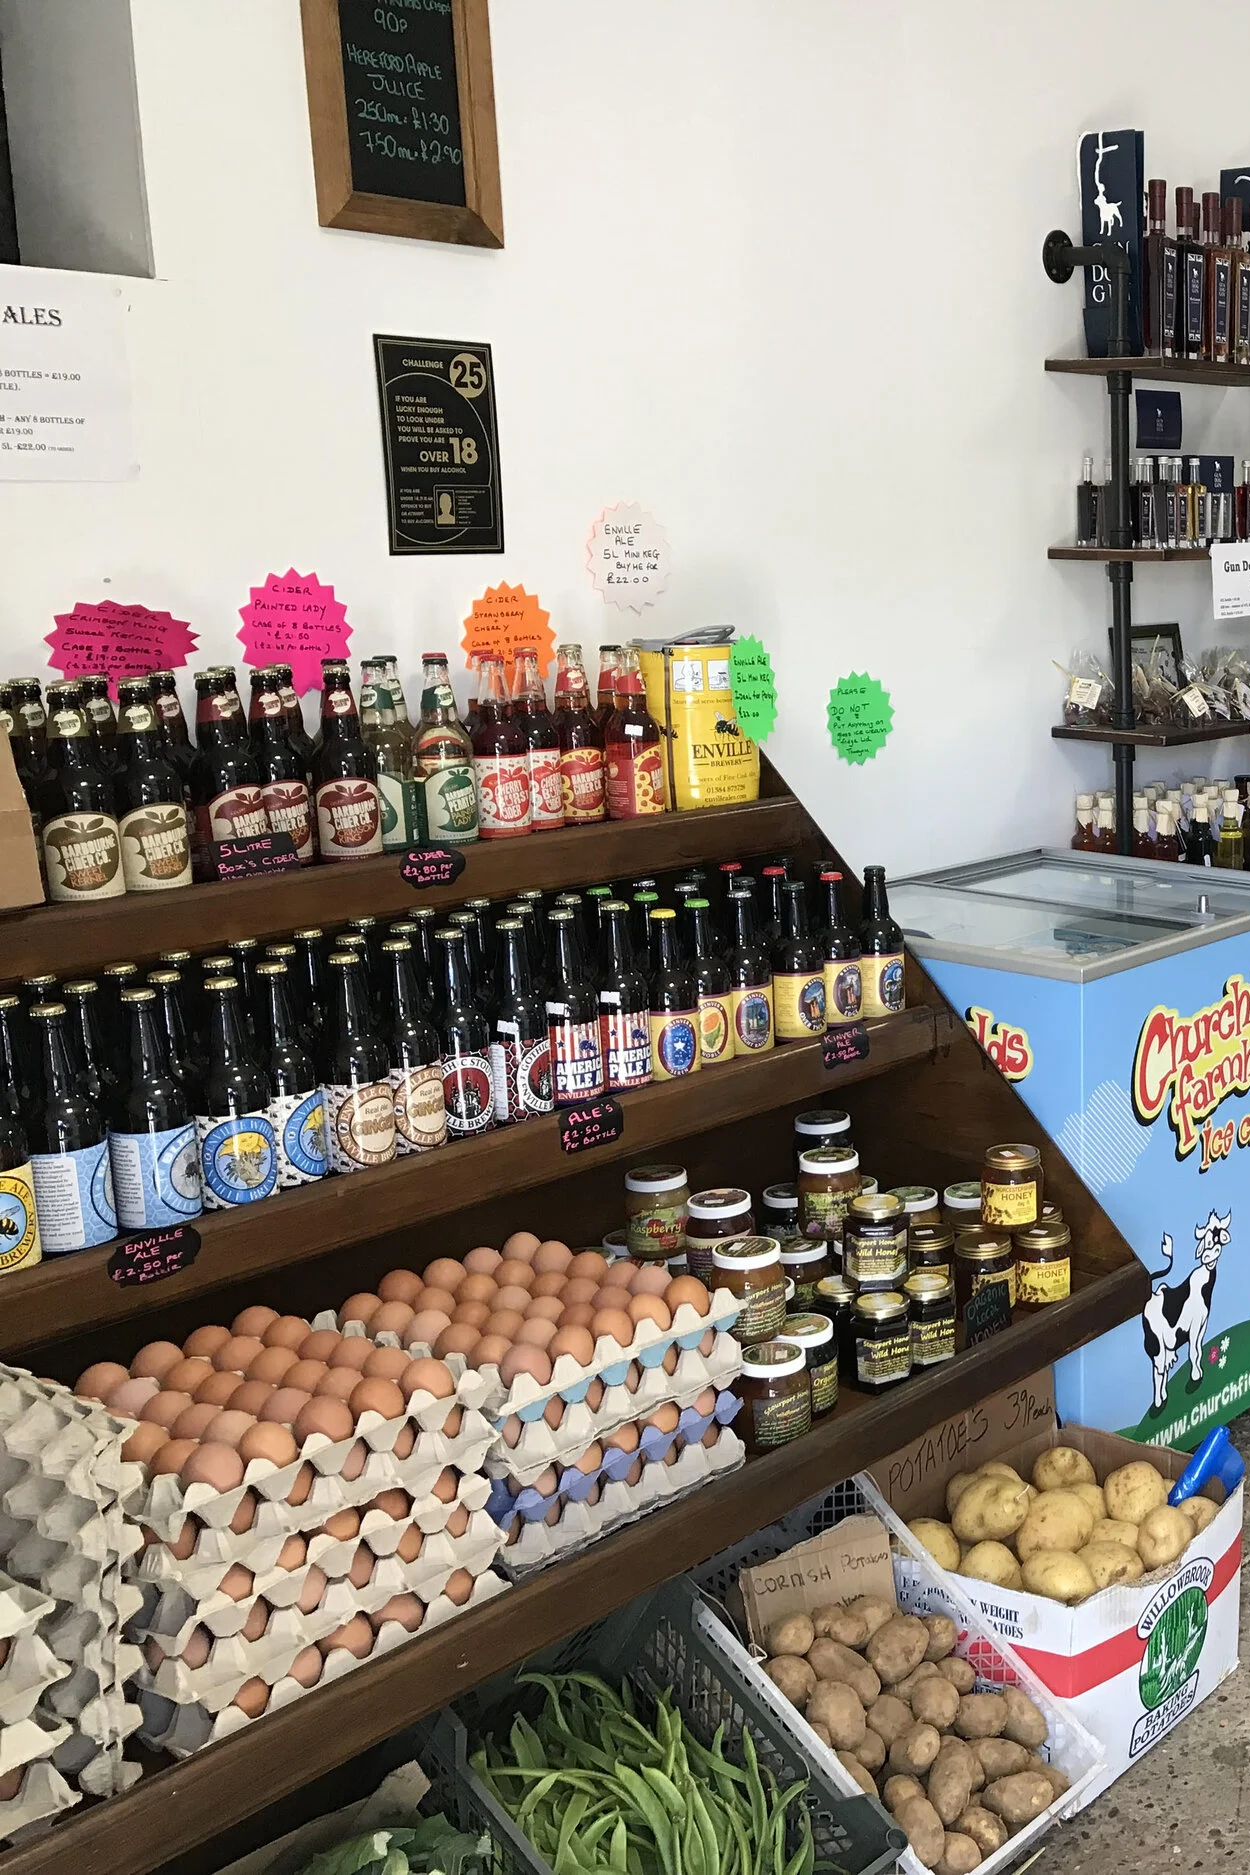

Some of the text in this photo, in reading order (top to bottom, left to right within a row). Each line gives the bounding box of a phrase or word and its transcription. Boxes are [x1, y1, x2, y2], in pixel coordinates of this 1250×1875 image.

[347, 43, 442, 80] HEREFORD APPLE
[367, 74, 425, 100] JUICE
[412, 107, 449, 134] £1.30
[421, 139, 462, 165] £2.90
[3, 306, 62, 327] ALES
[5, 370, 80, 381] BOTTLES £19.00
[402, 359, 483, 389] CHALLENGE 25
[417, 406, 443, 414] ENOUGH
[15, 415, 31, 423] ANY
[40, 416, 74, 424] BOTTLES
[425, 416, 445, 424] UNDER
[420, 437, 478, 464] OVER 18
[605, 524, 642, 534] ENVILLE
[615, 535, 634, 546] ALE
[603, 549, 660, 560] 5L MINI KEG
[616, 562, 631, 572] BUY
[1224, 561, 1240, 572] Gun
[607, 572, 649, 584] £22.00
[272, 585, 312, 595] CIDER
[97, 606, 159, 621] CIDER
[255, 599, 326, 620] PAINTED LADY
[475, 611, 524, 620] STRAWBERRY
[70, 614, 128, 625] CRIMSON
[252, 620, 272, 628] CASE
[475, 624, 509, 632] CHERRY
[838, 688, 866, 696] PLEASE
[831, 703, 870, 716] DO NOT
[692, 740, 752, 759] ENVILLE
[710, 759, 742, 767] BREWERY
[495, 779, 522, 797] CHERRY
[574, 782, 595, 795] CIDER
[497, 792, 529, 807] BURST
[331, 798, 376, 819] BARBOURNE
[499, 805, 522, 819] CIDER
[272, 816, 295, 833] CIDER
[334, 814, 373, 832] CIDER CO.
[453, 816, 471, 827] LADY
[337, 823, 375, 838] CRIMSON
[60, 833, 116, 859] BARBOURNE
[339, 833, 362, 844] KING
[145, 844, 171, 861] CIDER
[219, 838, 272, 858] 5 LITRE
[64, 851, 111, 872] CIDER CO.
[150, 858, 180, 870] SWEET
[262, 853, 298, 866] CIDER
[408, 851, 451, 862] CIDER
[69, 865, 103, 880] SWEET
[403, 864, 437, 876] £2.80
[71, 872, 109, 888] KERNEL
[800, 1012, 813, 1029] OVER
[823, 1027, 862, 1044] KINVER
[836, 1040, 851, 1048] ALE
[522, 1042, 550, 1072] GOTHIC
[609, 1062, 643, 1078] PALE
[557, 1072, 593, 1091] PALE
[609, 1077, 640, 1087] ENVILLE
[420, 1088, 432, 1096] Real
[558, 1089, 589, 1100] ENVILLE
[365, 1106, 379, 1115] Real
[568, 1103, 614, 1126] ALE'S
[563, 1124, 600, 1142] £2.50
[342, 1134, 378, 1163] ENVILLE
[1202, 1115, 1235, 1167] ice
[1001, 1191, 1033, 1201] HONEY
[631, 1223, 681, 1237] Raspberry
[125, 1228, 184, 1254] ENVILLE
[133, 1246, 160, 1262] ALE
[112, 1261, 161, 1280] £2.50
[1037, 1268, 1068, 1279] HONEY
[967, 1283, 1006, 1320] ORGANIC
[863, 1338, 893, 1349] Stourport
[921, 1332, 937, 1341] Wild
[871, 1348, 888, 1359] Wild
[888, 1408, 988, 1502] POTATOE'S
[753, 1564, 832, 1596] CORNISH
[1141, 1566, 1211, 1632] WILLOWBROOK
[980, 1602, 1020, 1624] WEIGHT
[1143, 1682, 1189, 1729] BAKING
[1133, 1690, 1194, 1751] POTATOES
